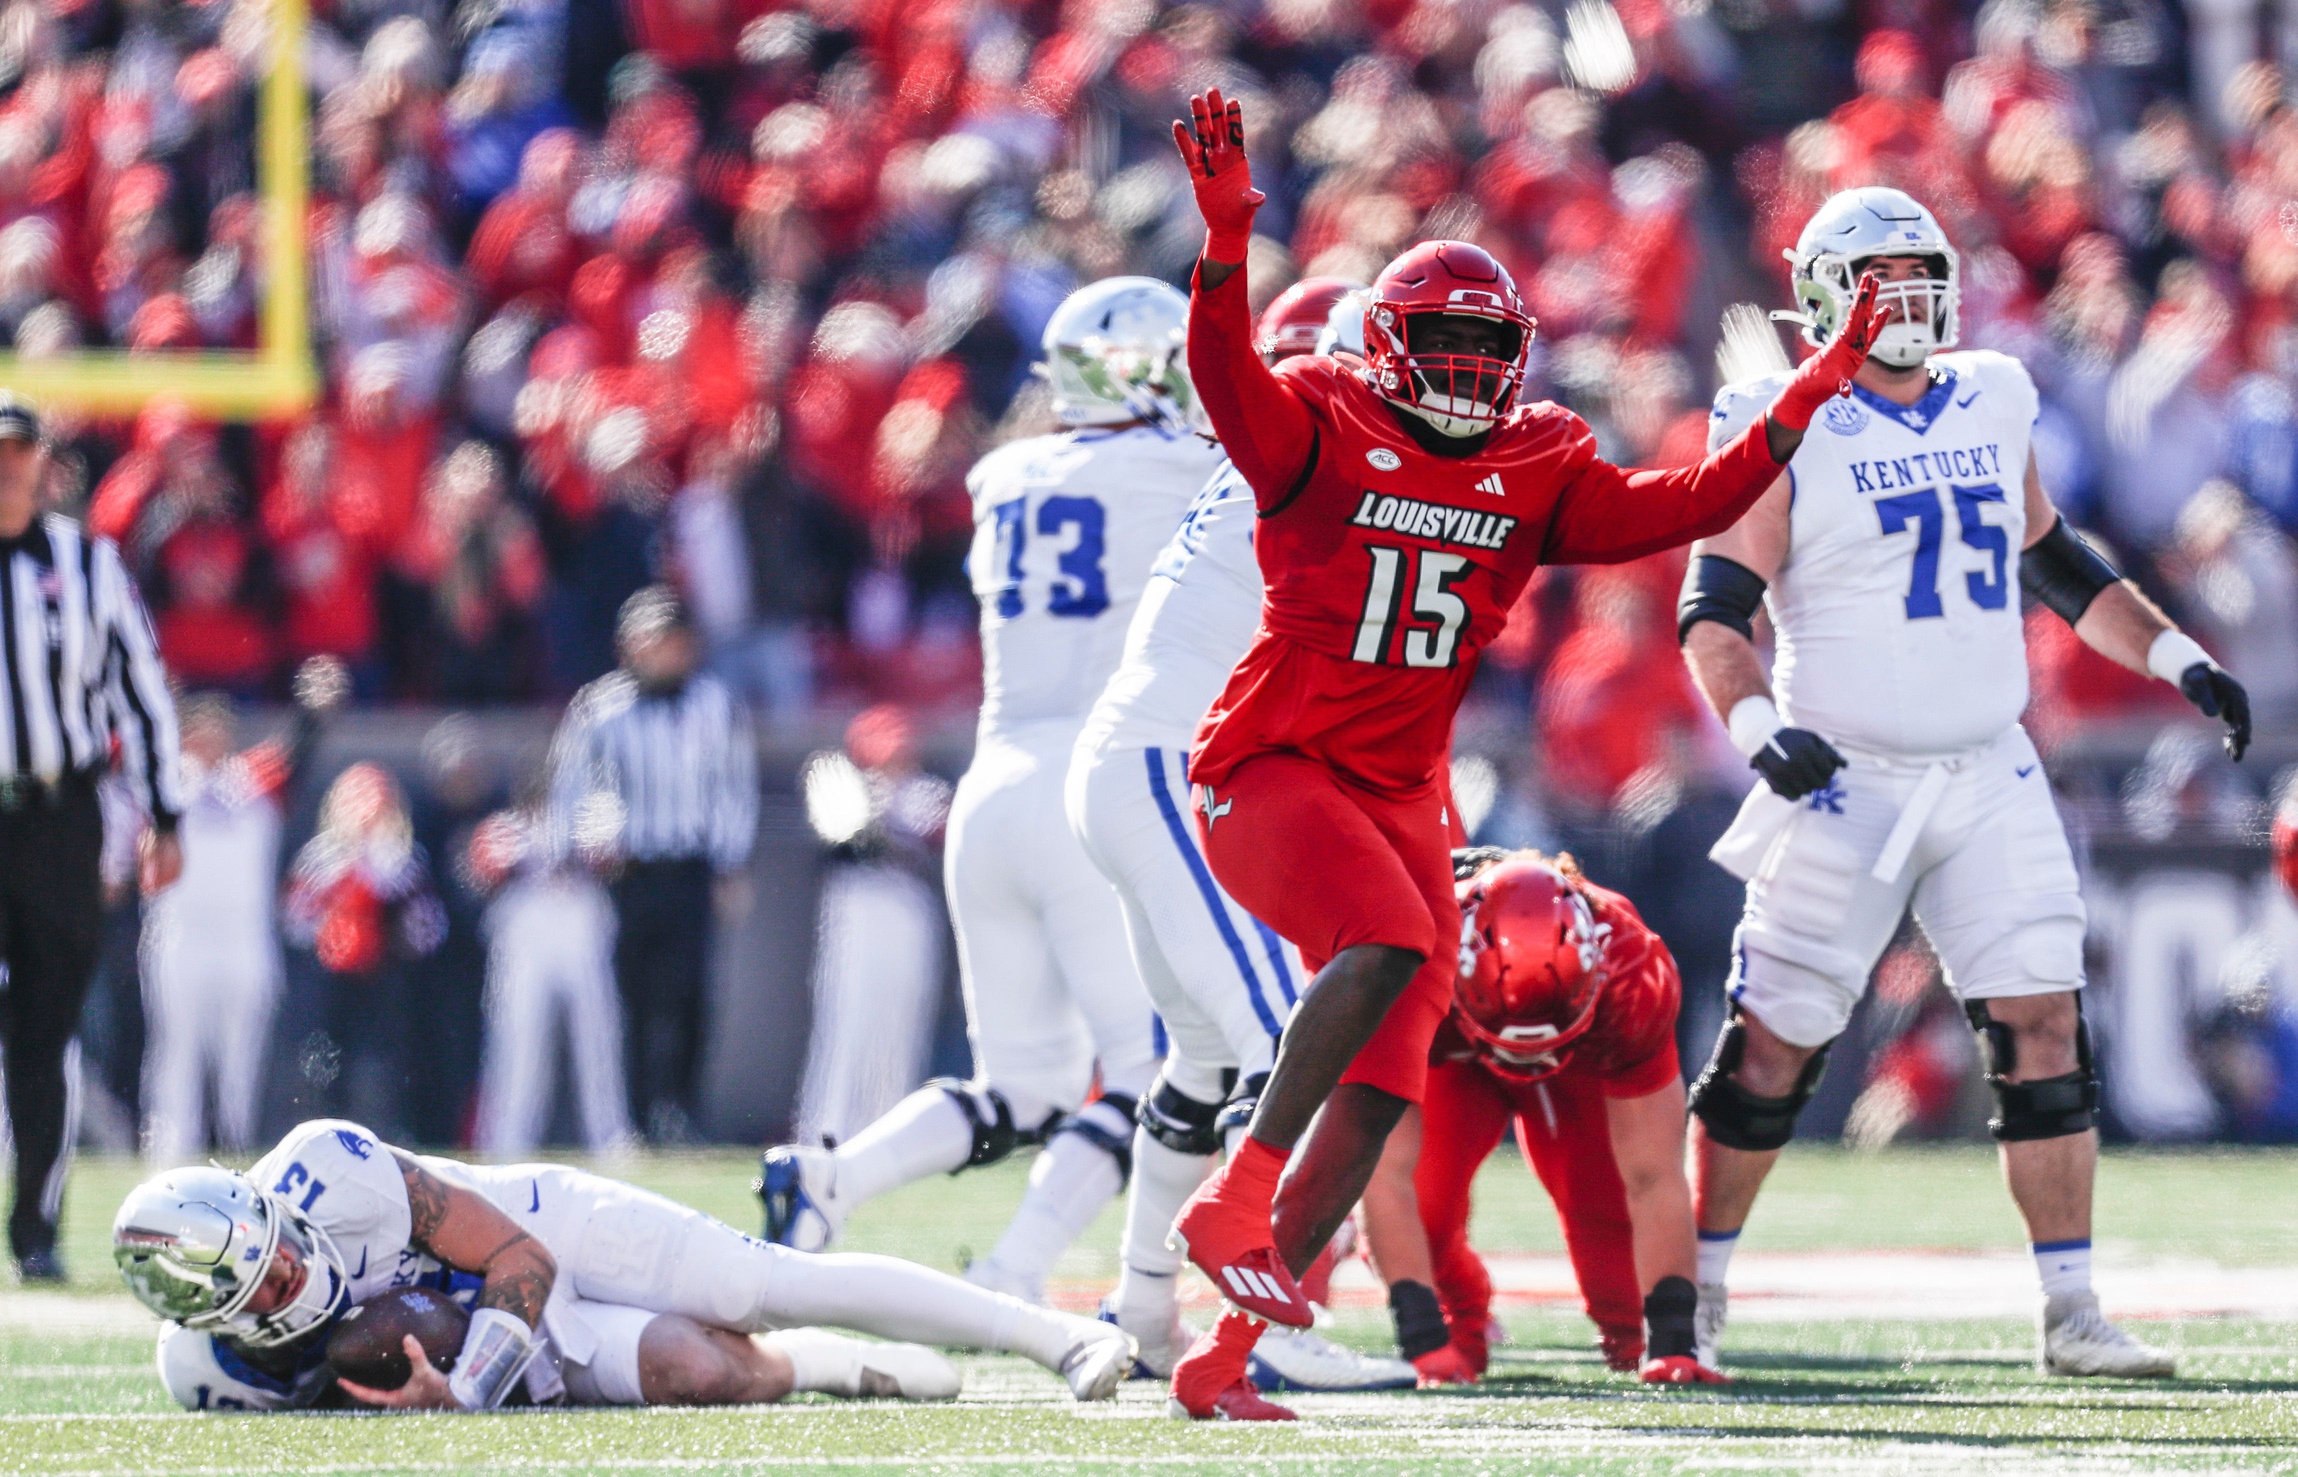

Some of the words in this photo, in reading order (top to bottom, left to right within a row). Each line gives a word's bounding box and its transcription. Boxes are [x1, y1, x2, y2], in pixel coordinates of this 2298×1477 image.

[1373, 454, 1395, 465] ACC
[1850, 444, 2001, 493] KENTUCKY
[995, 495, 1110, 620] 73
[1351, 491, 1517, 549] LOUISVILLE
[1874, 483, 2008, 620] 75
[1351, 545, 1473, 668] 15
